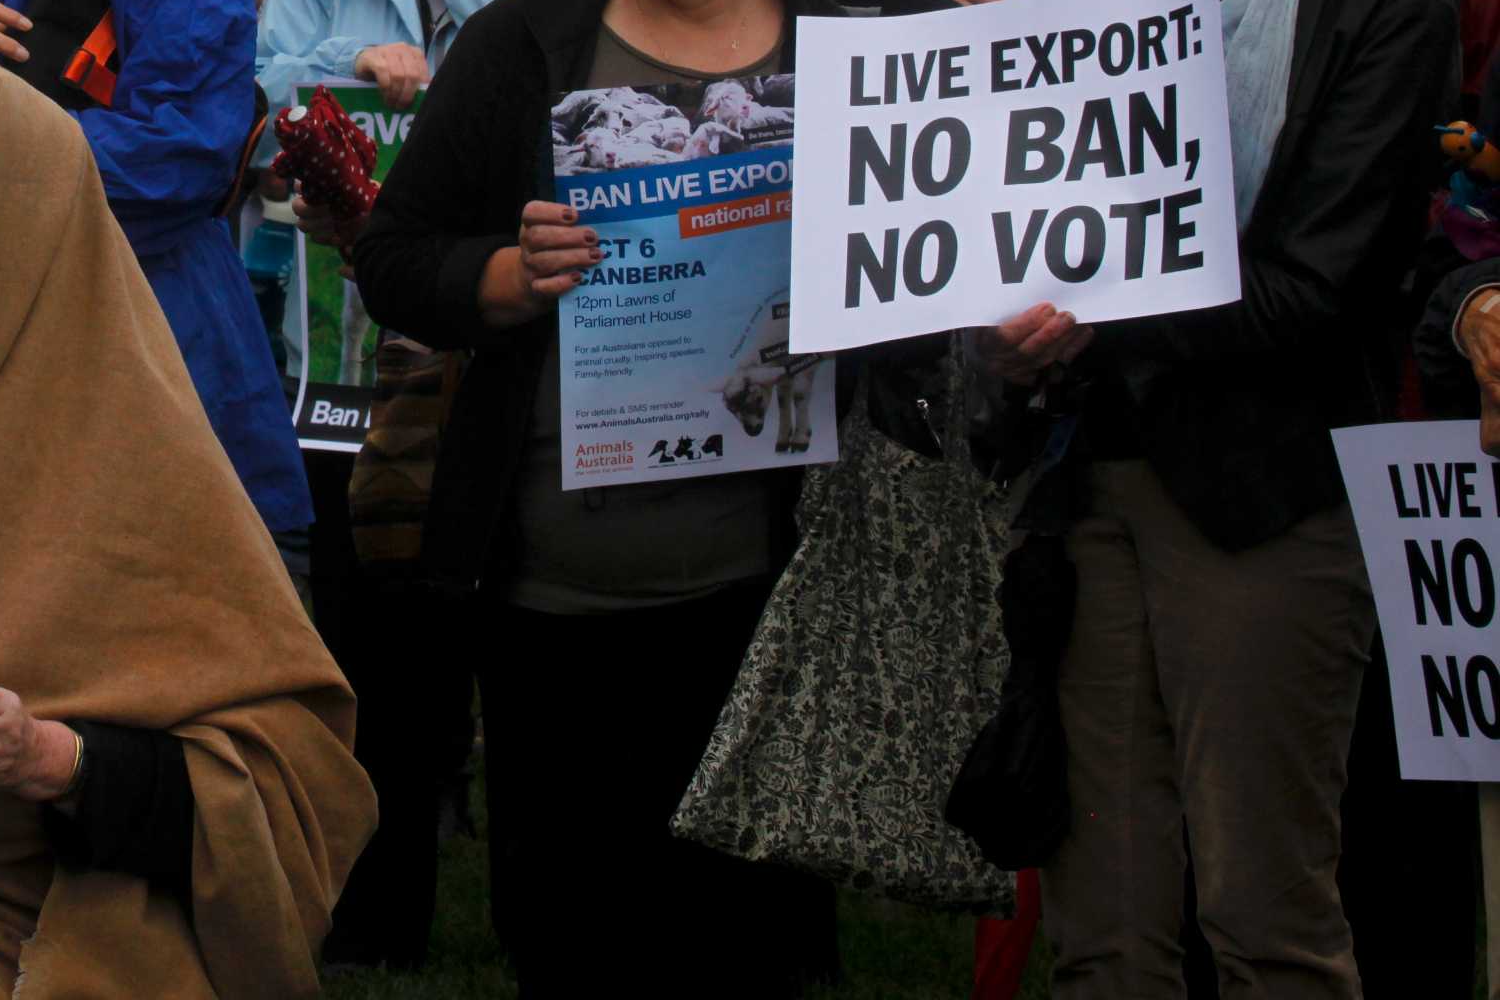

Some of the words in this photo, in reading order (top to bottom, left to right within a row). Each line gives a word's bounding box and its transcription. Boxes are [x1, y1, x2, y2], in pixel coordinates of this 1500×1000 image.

[850, 45, 970, 106] LIVE
[991, 3, 1203, 93] EXPORT:
[848, 116, 972, 206] NO
[1003, 84, 1201, 186] BAN,
[568, 182, 632, 212] BAN
[639, 172, 703, 205] LIVE
[708, 159, 793, 194] EXPO
[690, 198, 771, 231] national
[639, 237, 656, 259] 6
[844, 219, 959, 309] NO
[991, 187, 1204, 286] VOTE
[575, 295, 612, 312] 12pm
[616, 294, 660, 308] Lawns
[663, 289, 677, 303] of
[574, 312, 647, 329] Parliament
[650, 308, 693, 324] House
[574, 345, 589, 354] For
[591, 344, 600, 353] all
[602, 341, 646, 353] Australians
[647, 336, 682, 349] opposed
[683, 335, 692, 345] to
[574, 358, 601, 367] animal
[634, 350, 668, 363] Inspiring
[310, 400, 360, 428] Ban
[575, 409, 589, 418] For
[591, 406, 617, 417] details
[619, 405, 626, 415] &
[628, 403, 648, 414] SMS
[650, 401, 685, 412] reminder
[575, 409, 710, 430] www.AnimalsAustralia.org/rally
[575, 440, 634, 457] Animals
[575, 454, 634, 469] Australia
[1387, 462, 1482, 518] LIVE
[1403, 537, 1496, 628] NO
[1420, 654, 1500, 741] NO
